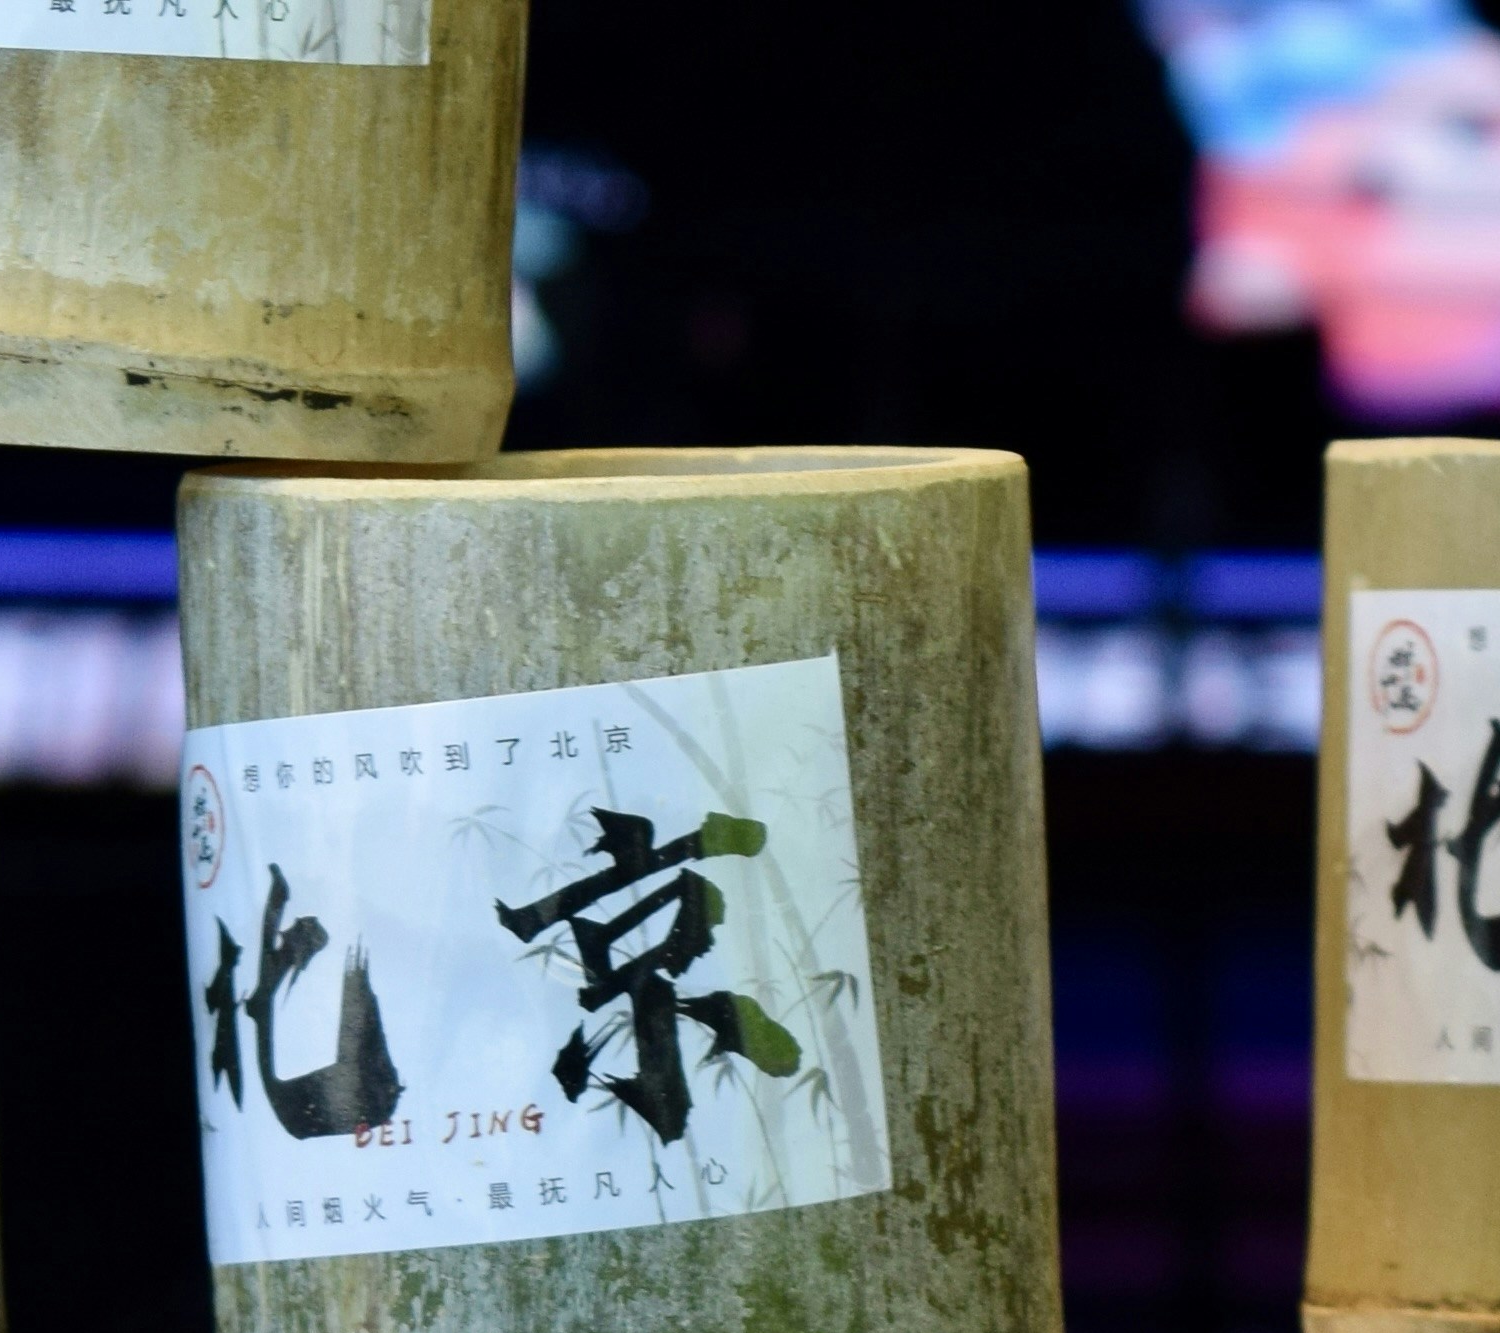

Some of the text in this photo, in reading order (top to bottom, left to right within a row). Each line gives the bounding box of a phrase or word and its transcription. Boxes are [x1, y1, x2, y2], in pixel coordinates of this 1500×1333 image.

[242, 724, 633, 793] 想你的风吹到了北京
[205, 806, 803, 1147] 北京
[354, 1103, 545, 1148] BEI JING
